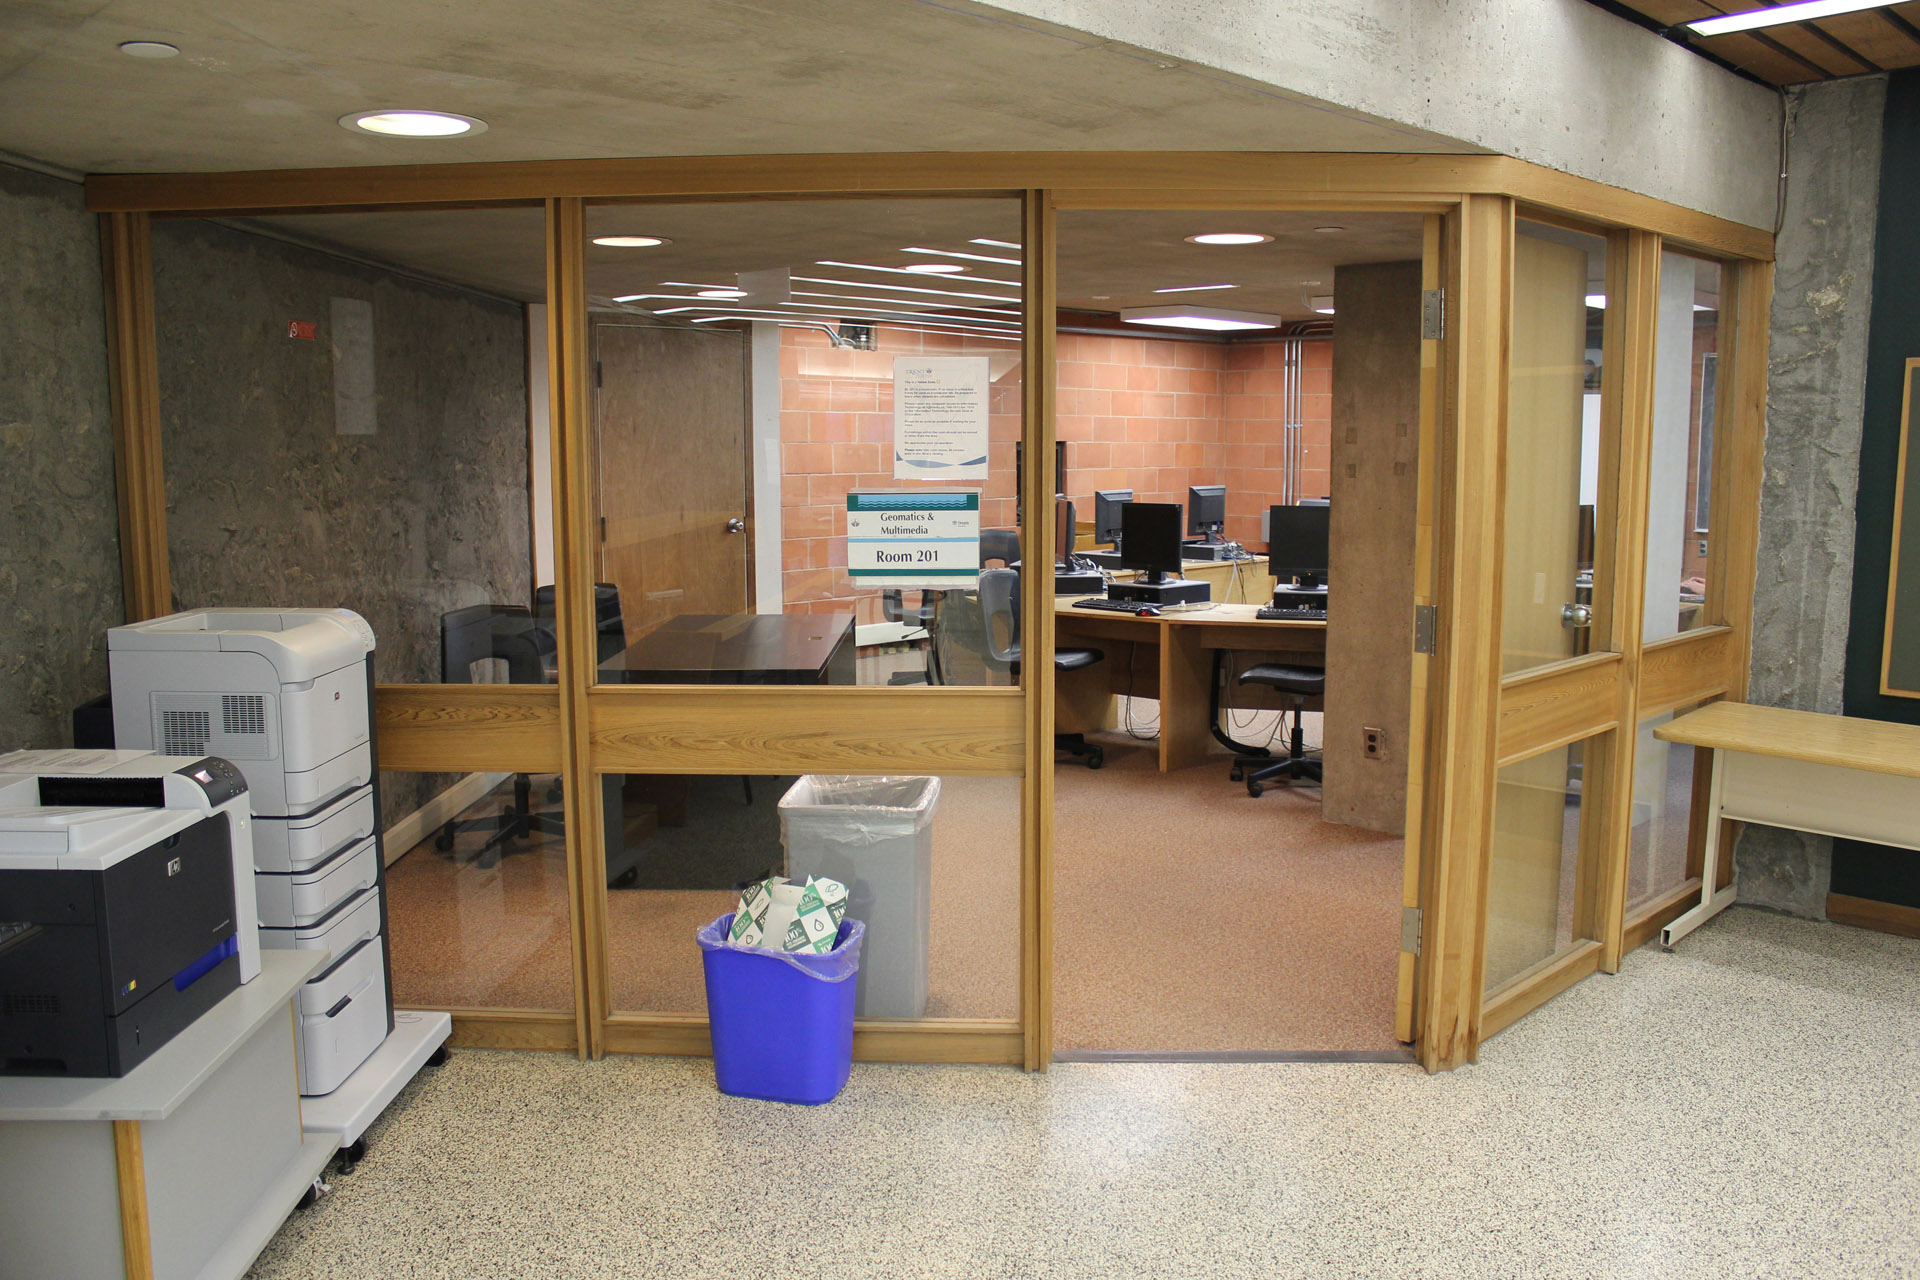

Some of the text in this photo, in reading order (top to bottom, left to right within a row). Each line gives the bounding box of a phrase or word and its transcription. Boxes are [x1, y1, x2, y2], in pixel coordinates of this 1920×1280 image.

[880, 512, 935, 522] Geomatics &
[880, 525, 929, 535] Multimedia
[876, 549, 939, 563] Room 201
